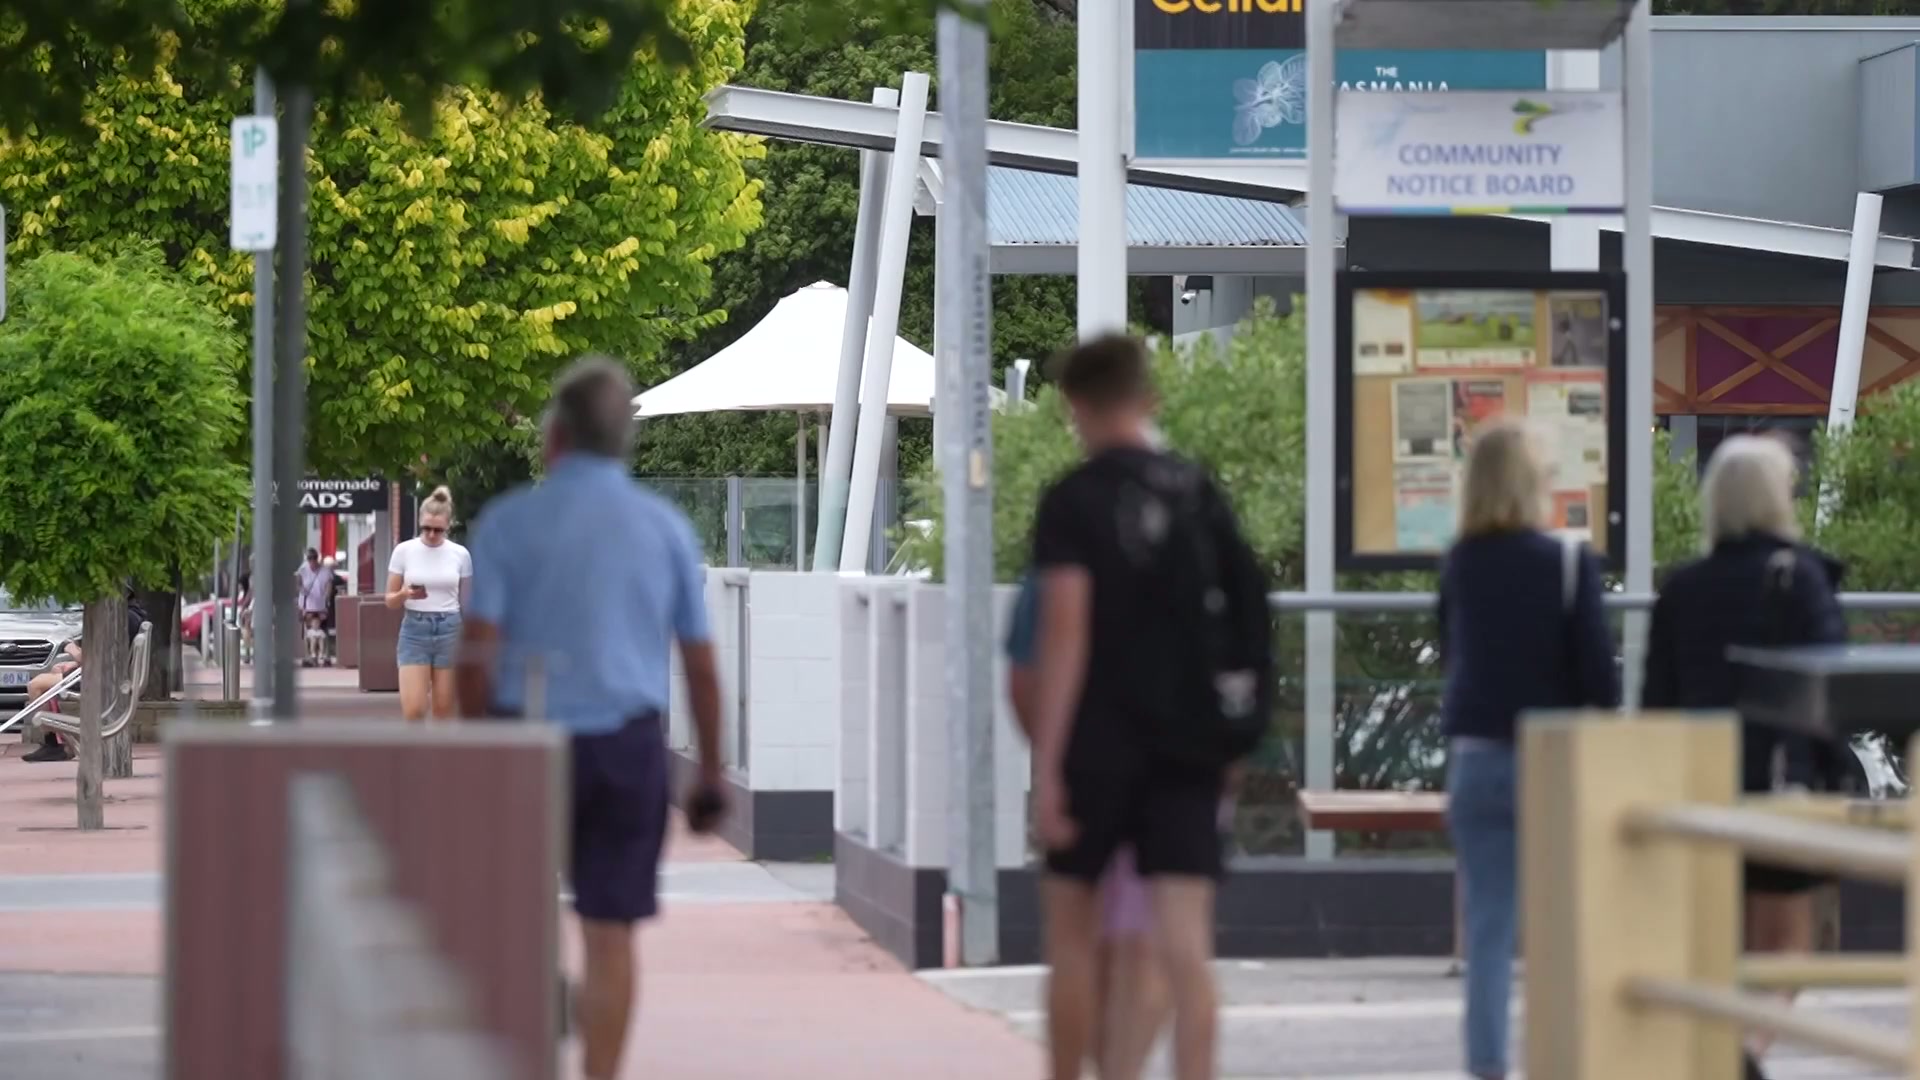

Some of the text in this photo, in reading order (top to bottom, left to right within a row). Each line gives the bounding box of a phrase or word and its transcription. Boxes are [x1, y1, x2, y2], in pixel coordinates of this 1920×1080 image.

[1375, 66, 1399, 79] THE
[1331, 81, 1449, 92] ASMANIA
[1398, 144, 1563, 167] COMMUNITY
[1386, 173, 1575, 196] NOTICE BOARD
